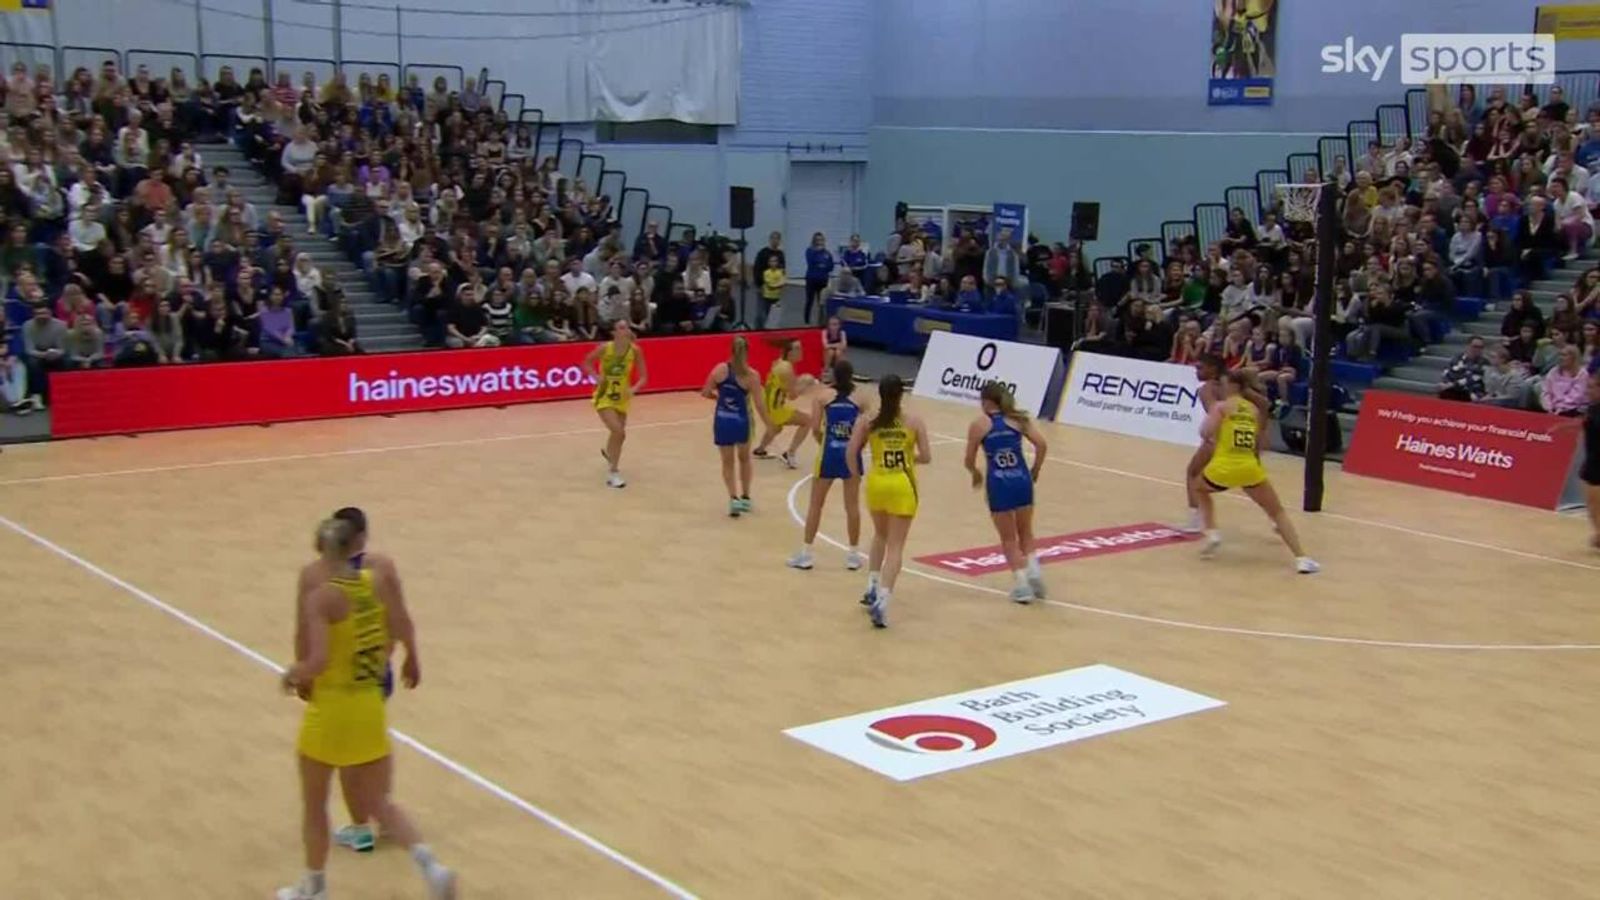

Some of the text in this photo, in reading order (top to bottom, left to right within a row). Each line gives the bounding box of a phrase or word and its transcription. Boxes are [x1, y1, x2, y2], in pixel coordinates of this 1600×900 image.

[349, 365, 598, 401] haineswatts.co.
[1082, 372, 1199, 408] RENGEN
[1395, 434, 1513, 468] Haines Watts
[959, 690, 1041, 711] Bath
[990, 688, 1138, 723] Building
[1023, 704, 1146, 736] Society
